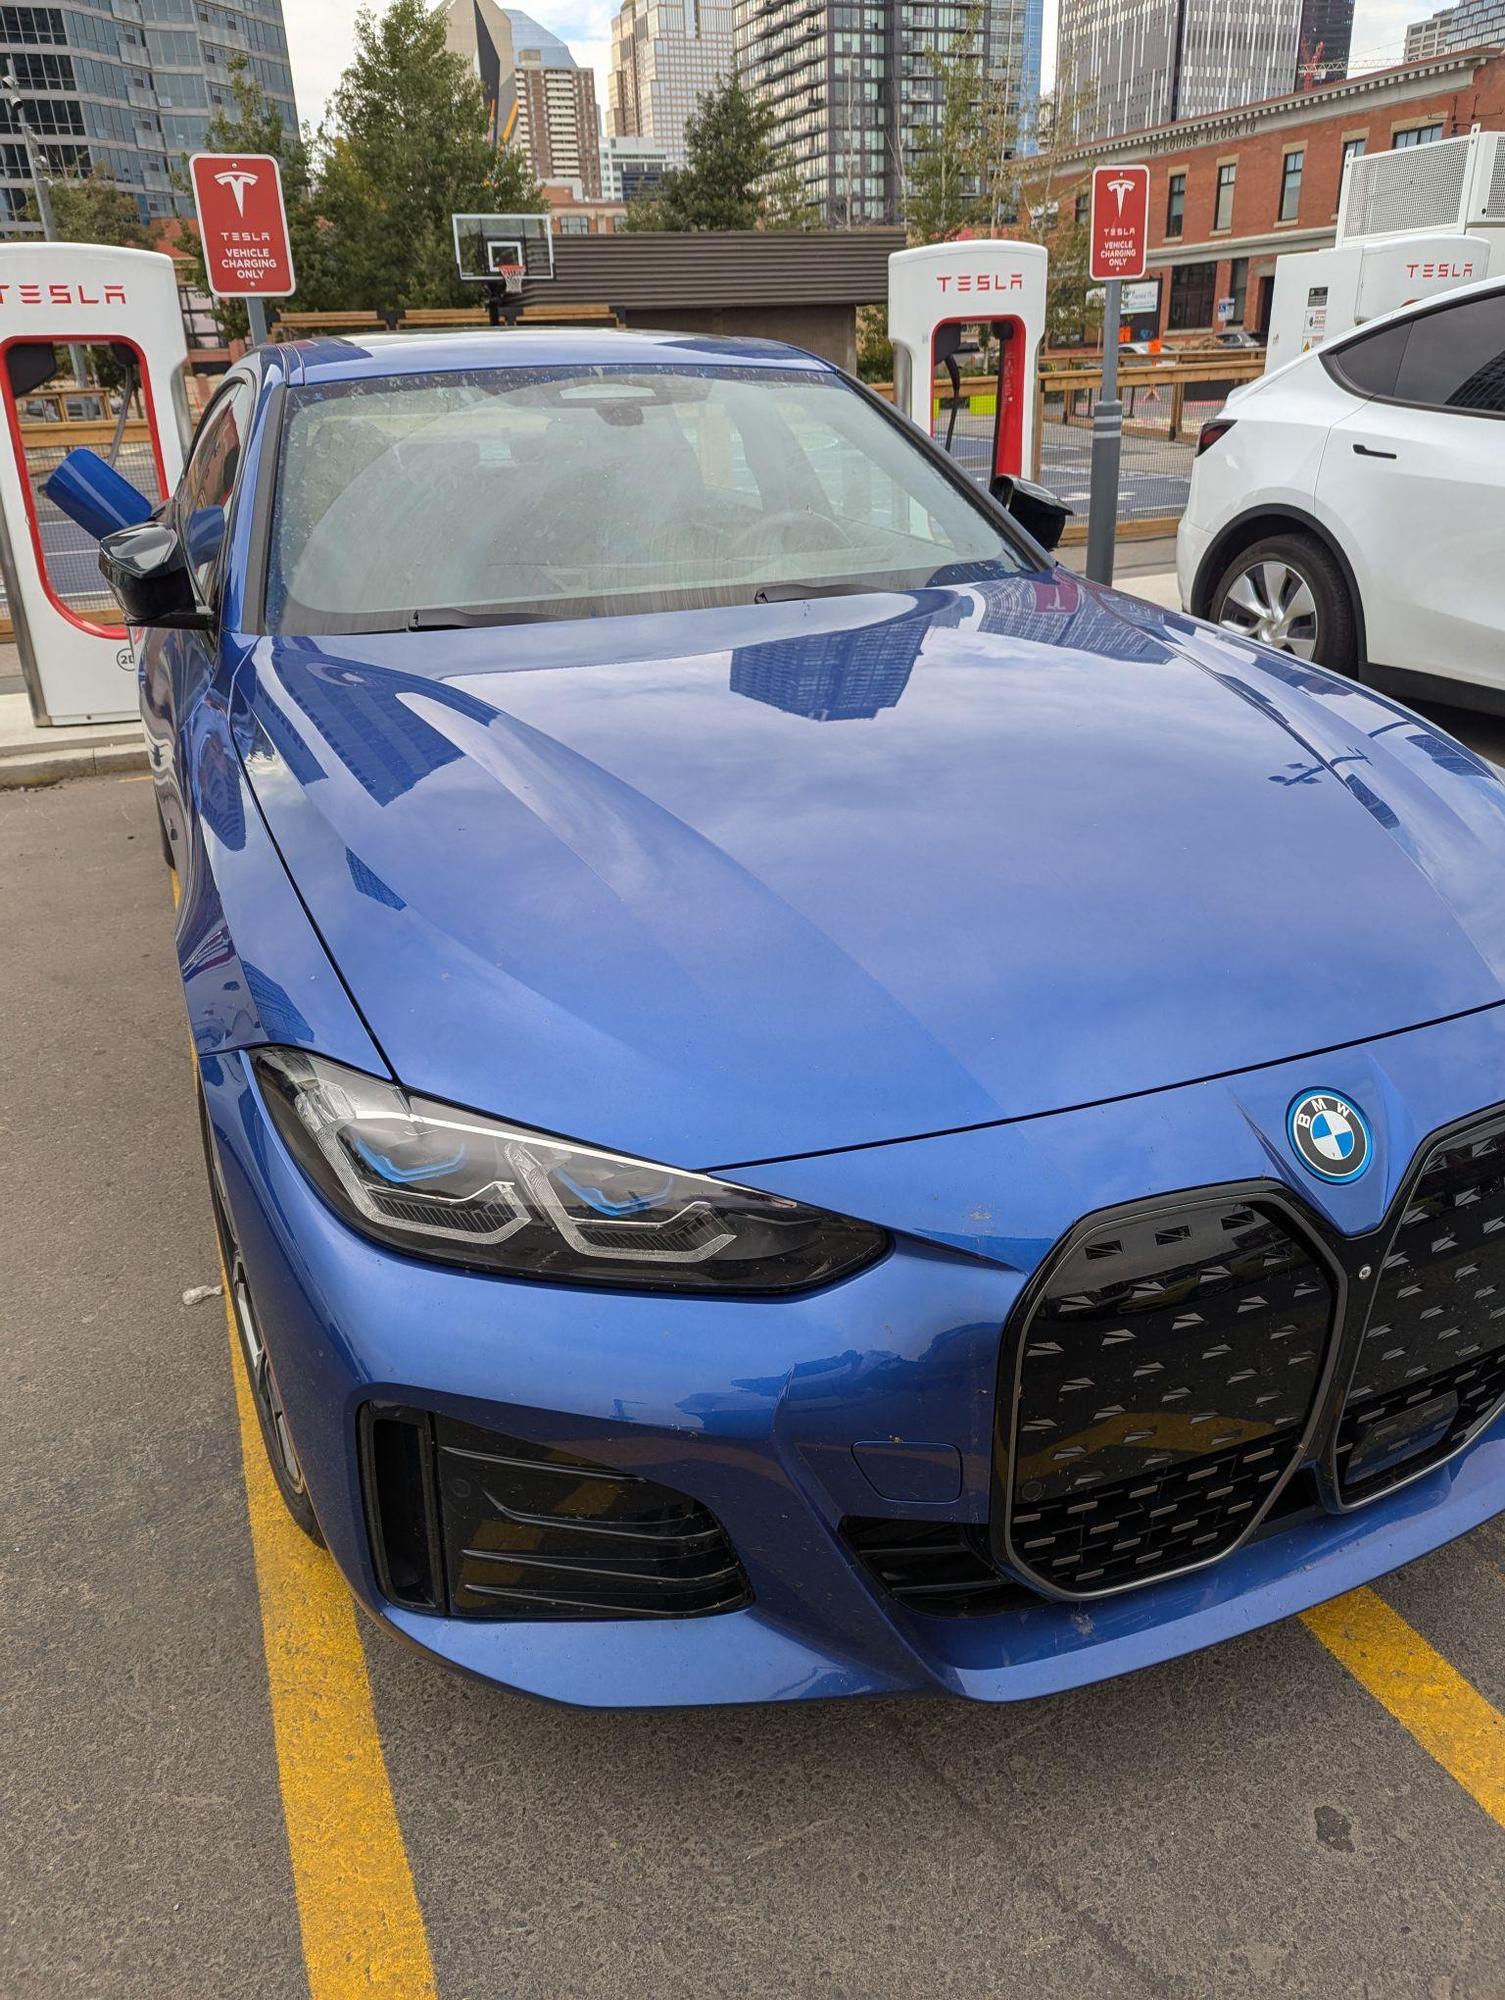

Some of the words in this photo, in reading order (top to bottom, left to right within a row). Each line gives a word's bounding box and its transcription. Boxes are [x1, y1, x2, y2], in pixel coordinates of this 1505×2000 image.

[220, 231, 271, 241] TESLA
[1103, 227, 1136, 236] TESLA
[1104, 240, 1134, 249] VEHICLE
[225, 248, 270, 258] VEHICLE
[1100, 249, 1137, 259] CHARGING
[221, 258, 278, 269] CHARGING
[1108, 257, 1128, 267] ONLY
[236, 269, 265, 279] ONLY
[1406, 262, 1473, 278] TESLA
[936, 273, 1022, 292] TESLA
[1297, 1098, 1350, 1129] BMW
